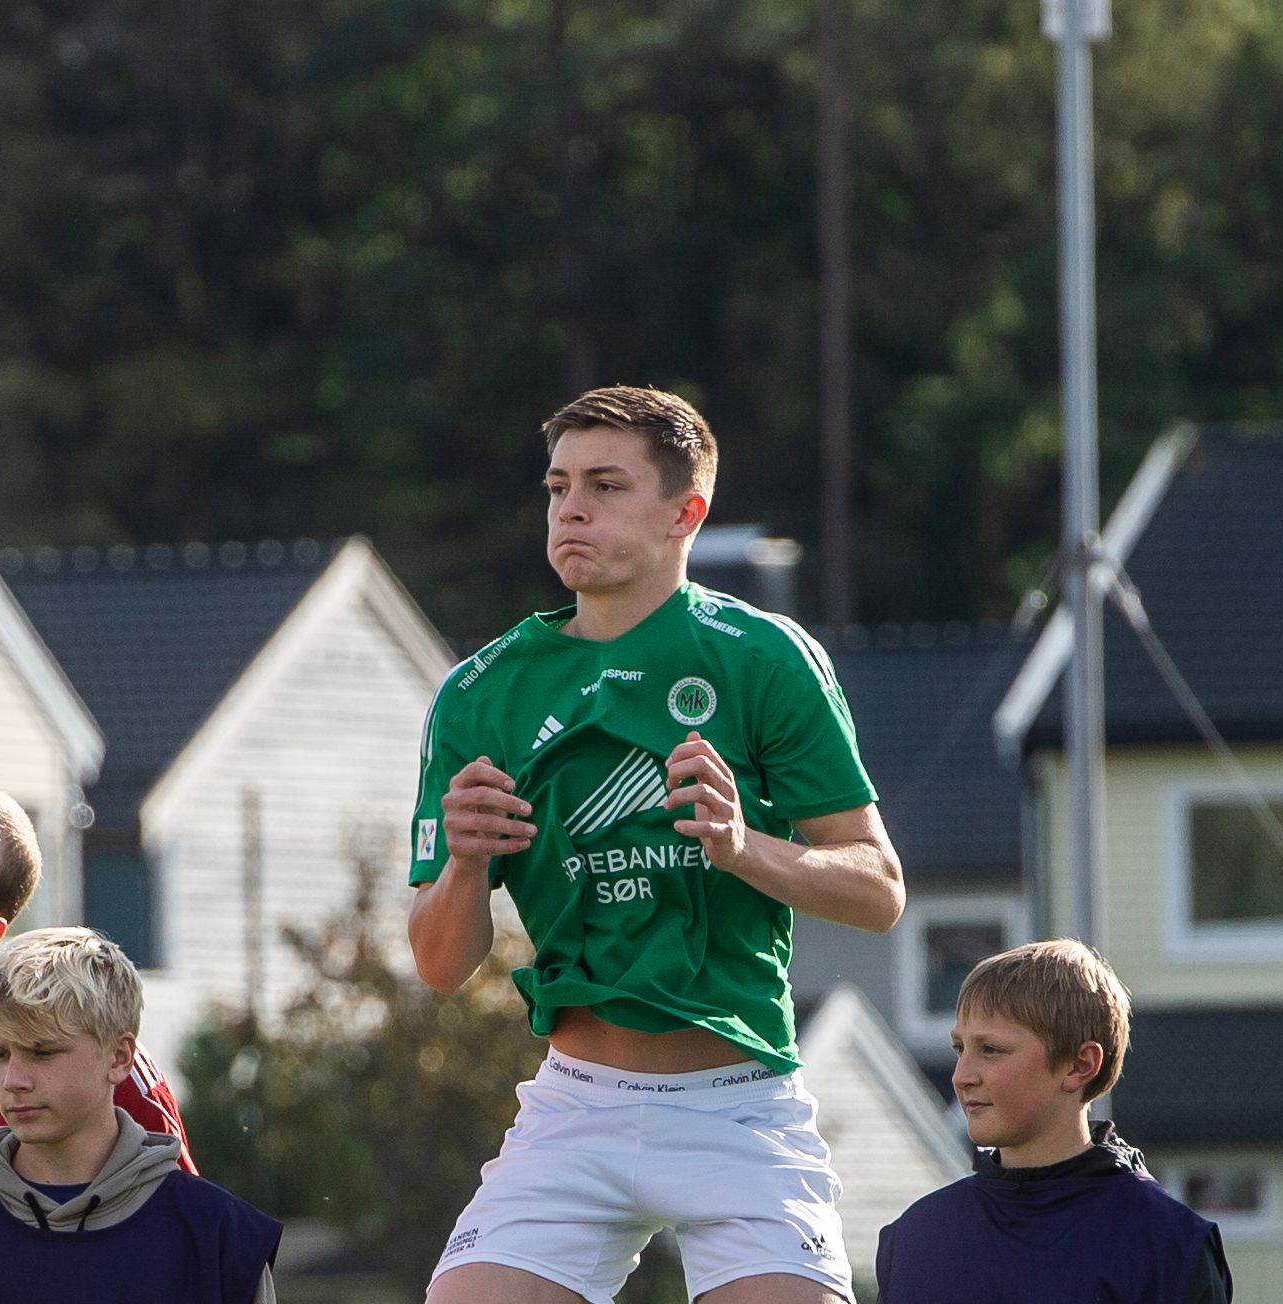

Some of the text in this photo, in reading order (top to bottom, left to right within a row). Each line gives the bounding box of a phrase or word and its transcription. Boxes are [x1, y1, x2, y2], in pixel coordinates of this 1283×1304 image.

[596, 877, 654, 904] SØR
[549, 1057, 594, 1084] Calvin Klein
